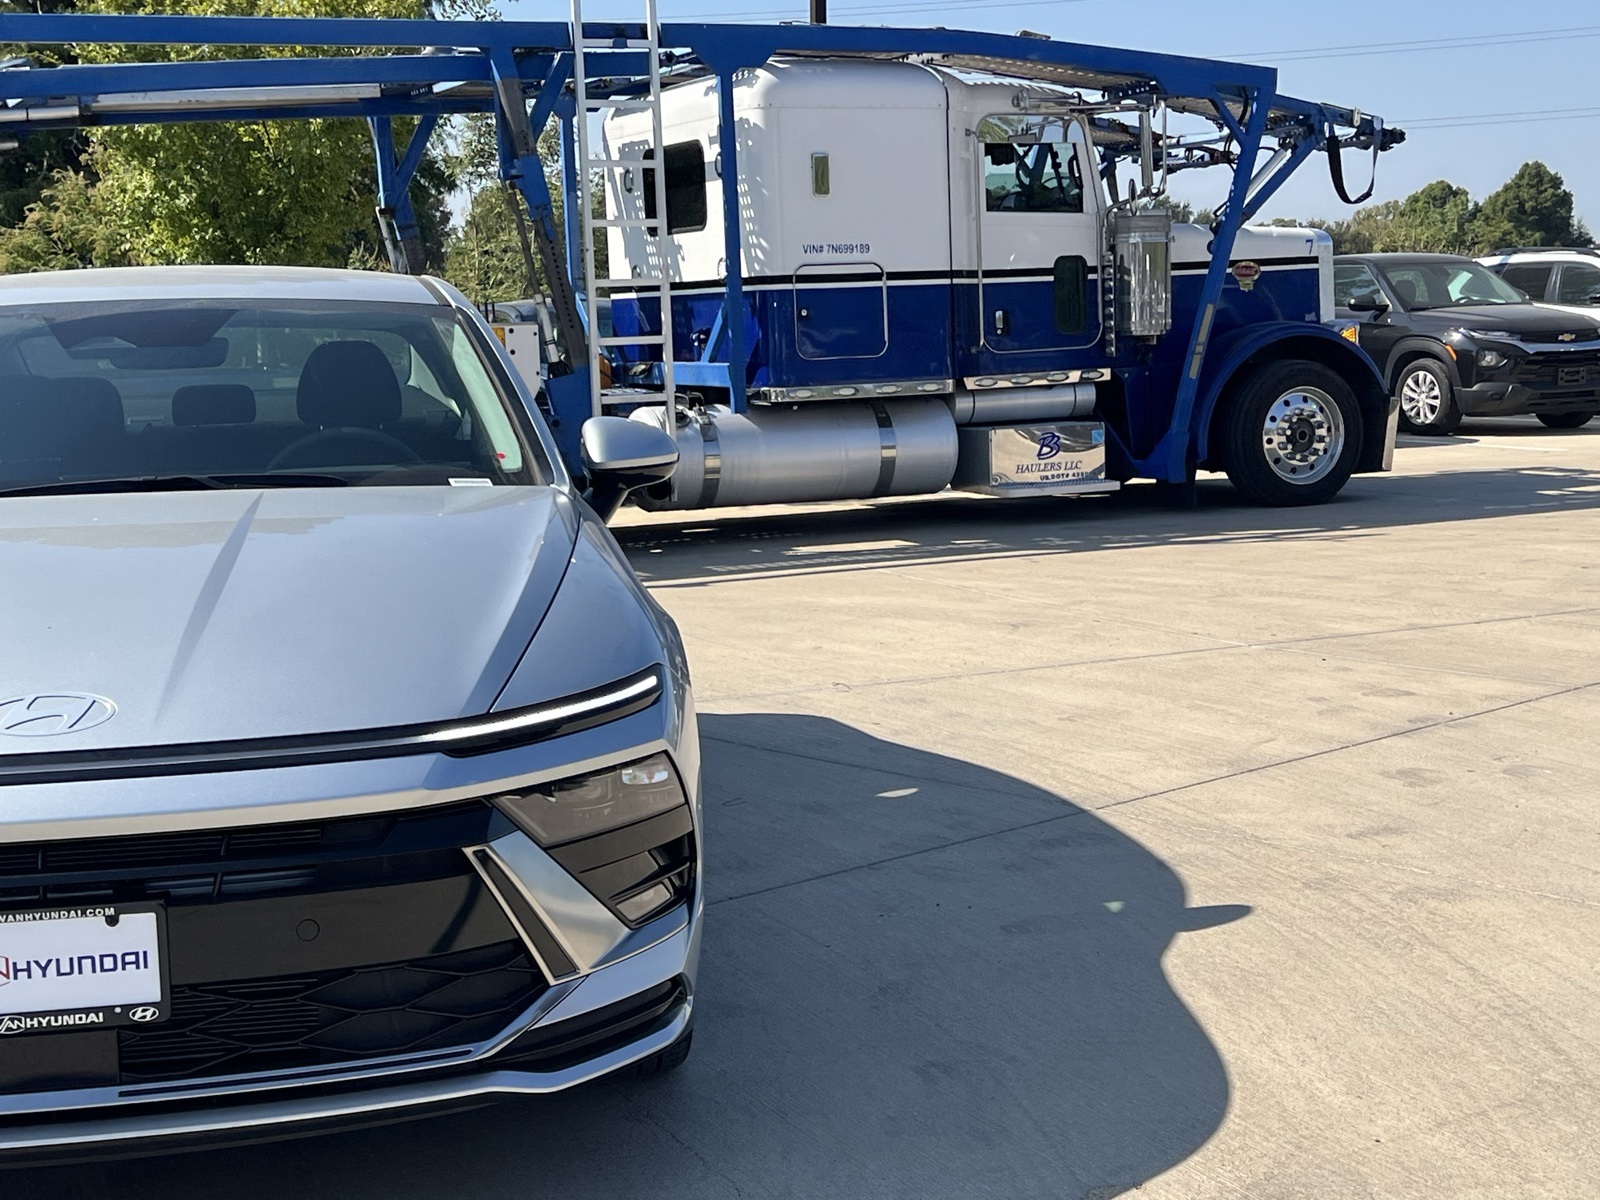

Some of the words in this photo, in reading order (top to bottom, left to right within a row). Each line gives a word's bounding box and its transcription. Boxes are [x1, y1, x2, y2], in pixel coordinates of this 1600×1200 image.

[802, 244, 824, 254] VIN#
[826, 243, 870, 254] 7N699189
[1015, 462, 1062, 474] HAULERS
[1064, 460, 1083, 470] LLC
